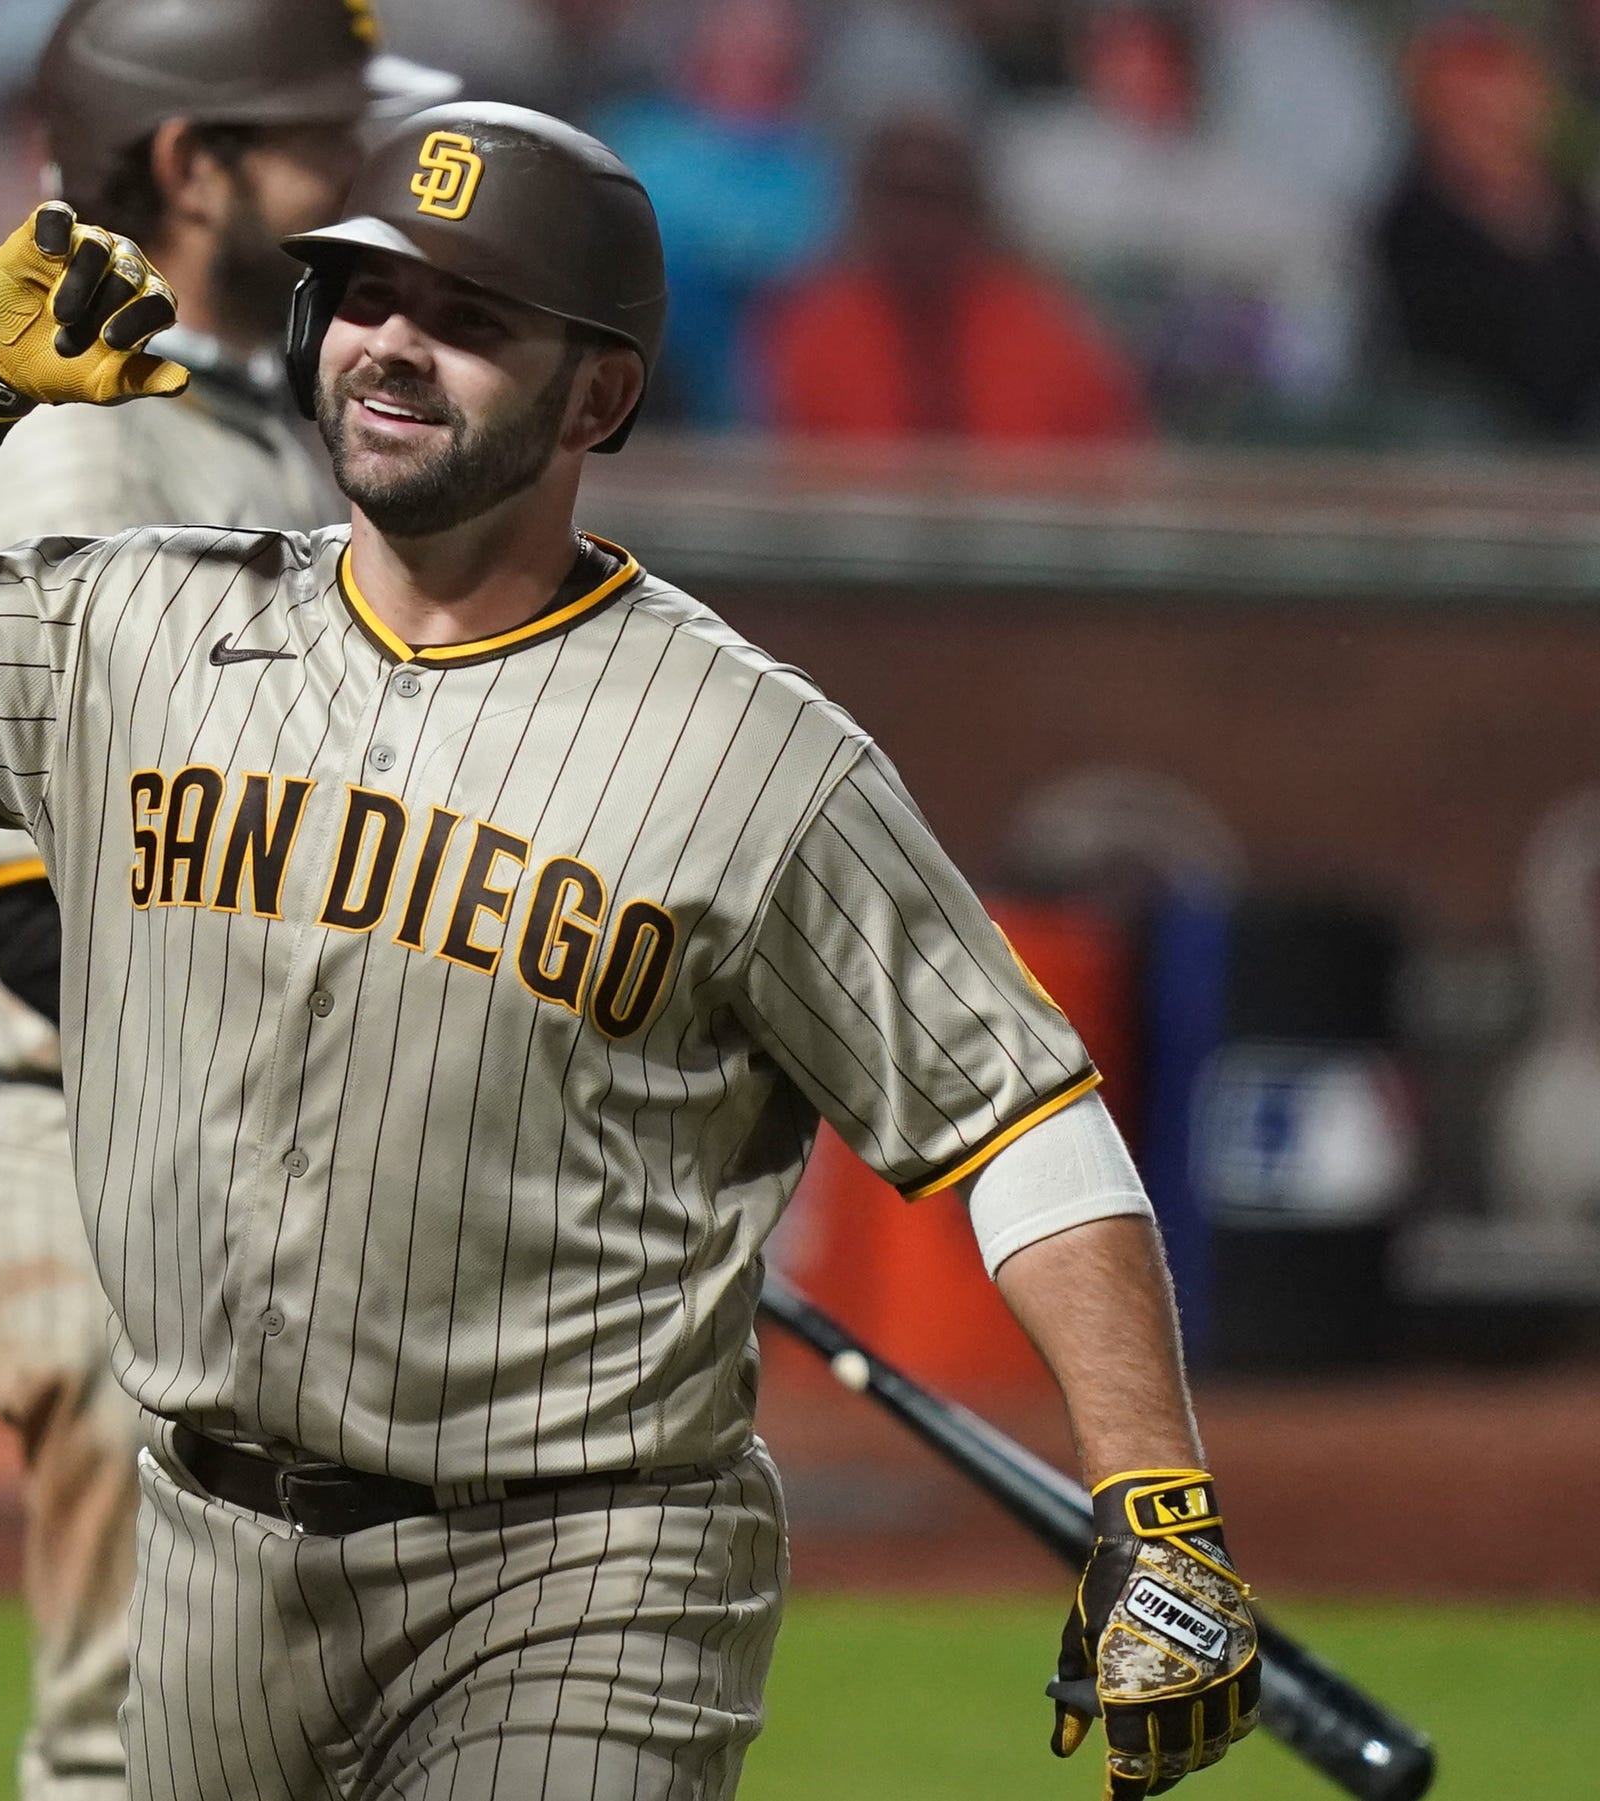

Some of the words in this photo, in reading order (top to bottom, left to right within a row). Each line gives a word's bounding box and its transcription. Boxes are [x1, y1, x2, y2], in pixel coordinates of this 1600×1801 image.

[410, 130, 485, 221] SD
[129, 765, 317, 920] SAN
[315, 783, 677, 1041] DIEGO
